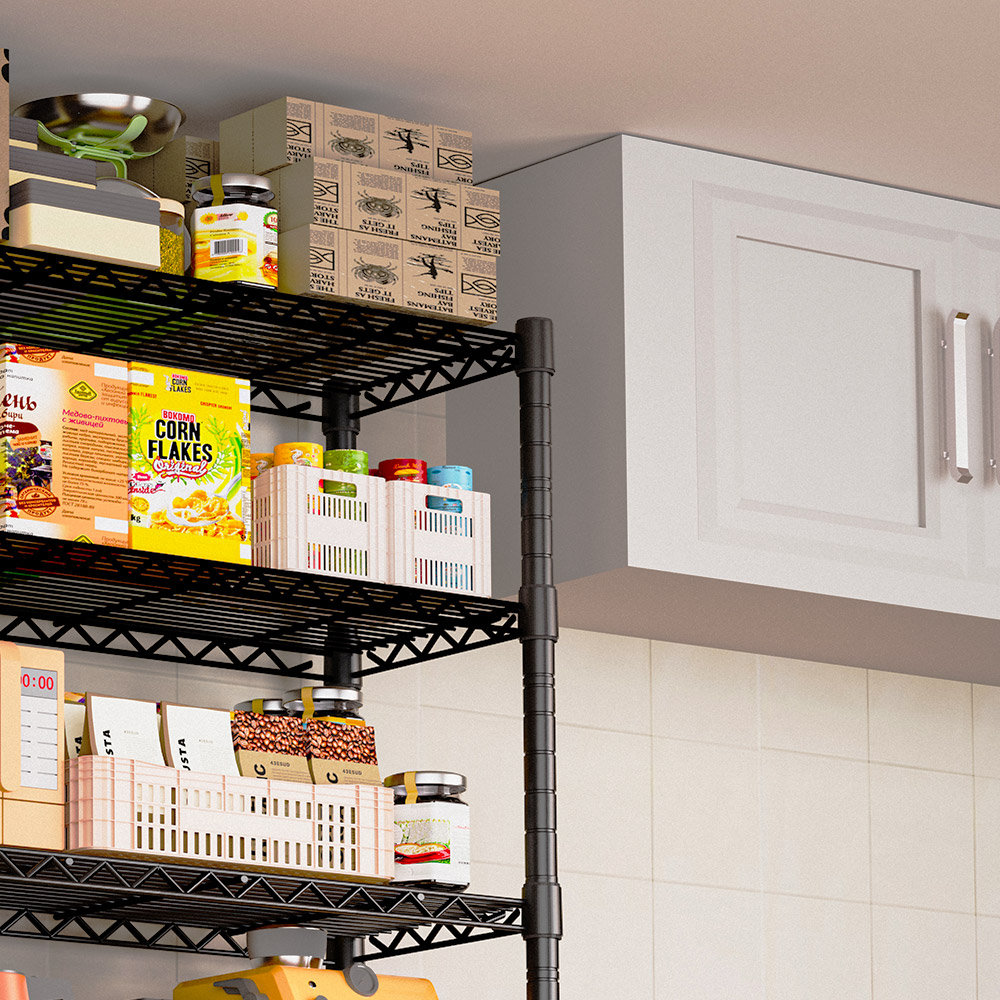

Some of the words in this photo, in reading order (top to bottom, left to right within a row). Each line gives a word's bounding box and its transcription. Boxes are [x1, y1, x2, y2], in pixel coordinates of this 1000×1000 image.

[394, 164, 430, 176] FISHING
[410, 161, 429, 170] TIPS
[362, 218, 386, 228] GETS
[421, 223, 457, 235] FISHING
[438, 221, 457, 229] TIPS
[373, 227, 399, 237] FRESH
[411, 233, 457, 247] BATEMANS
[358, 286, 382, 295] GETS
[417, 291, 453, 302] FISHING
[434, 287, 453, 296] TIPS
[368, 294, 395, 303] FRESH
[407, 300, 453, 313] BATEMANS
[162, 410, 195, 423] BOKOMO
[155, 419, 201, 441] CORN
[148, 439, 213, 462] FLAKES
[152, 458, 208, 475] Original
[20, 673, 54, 690] 0:00
